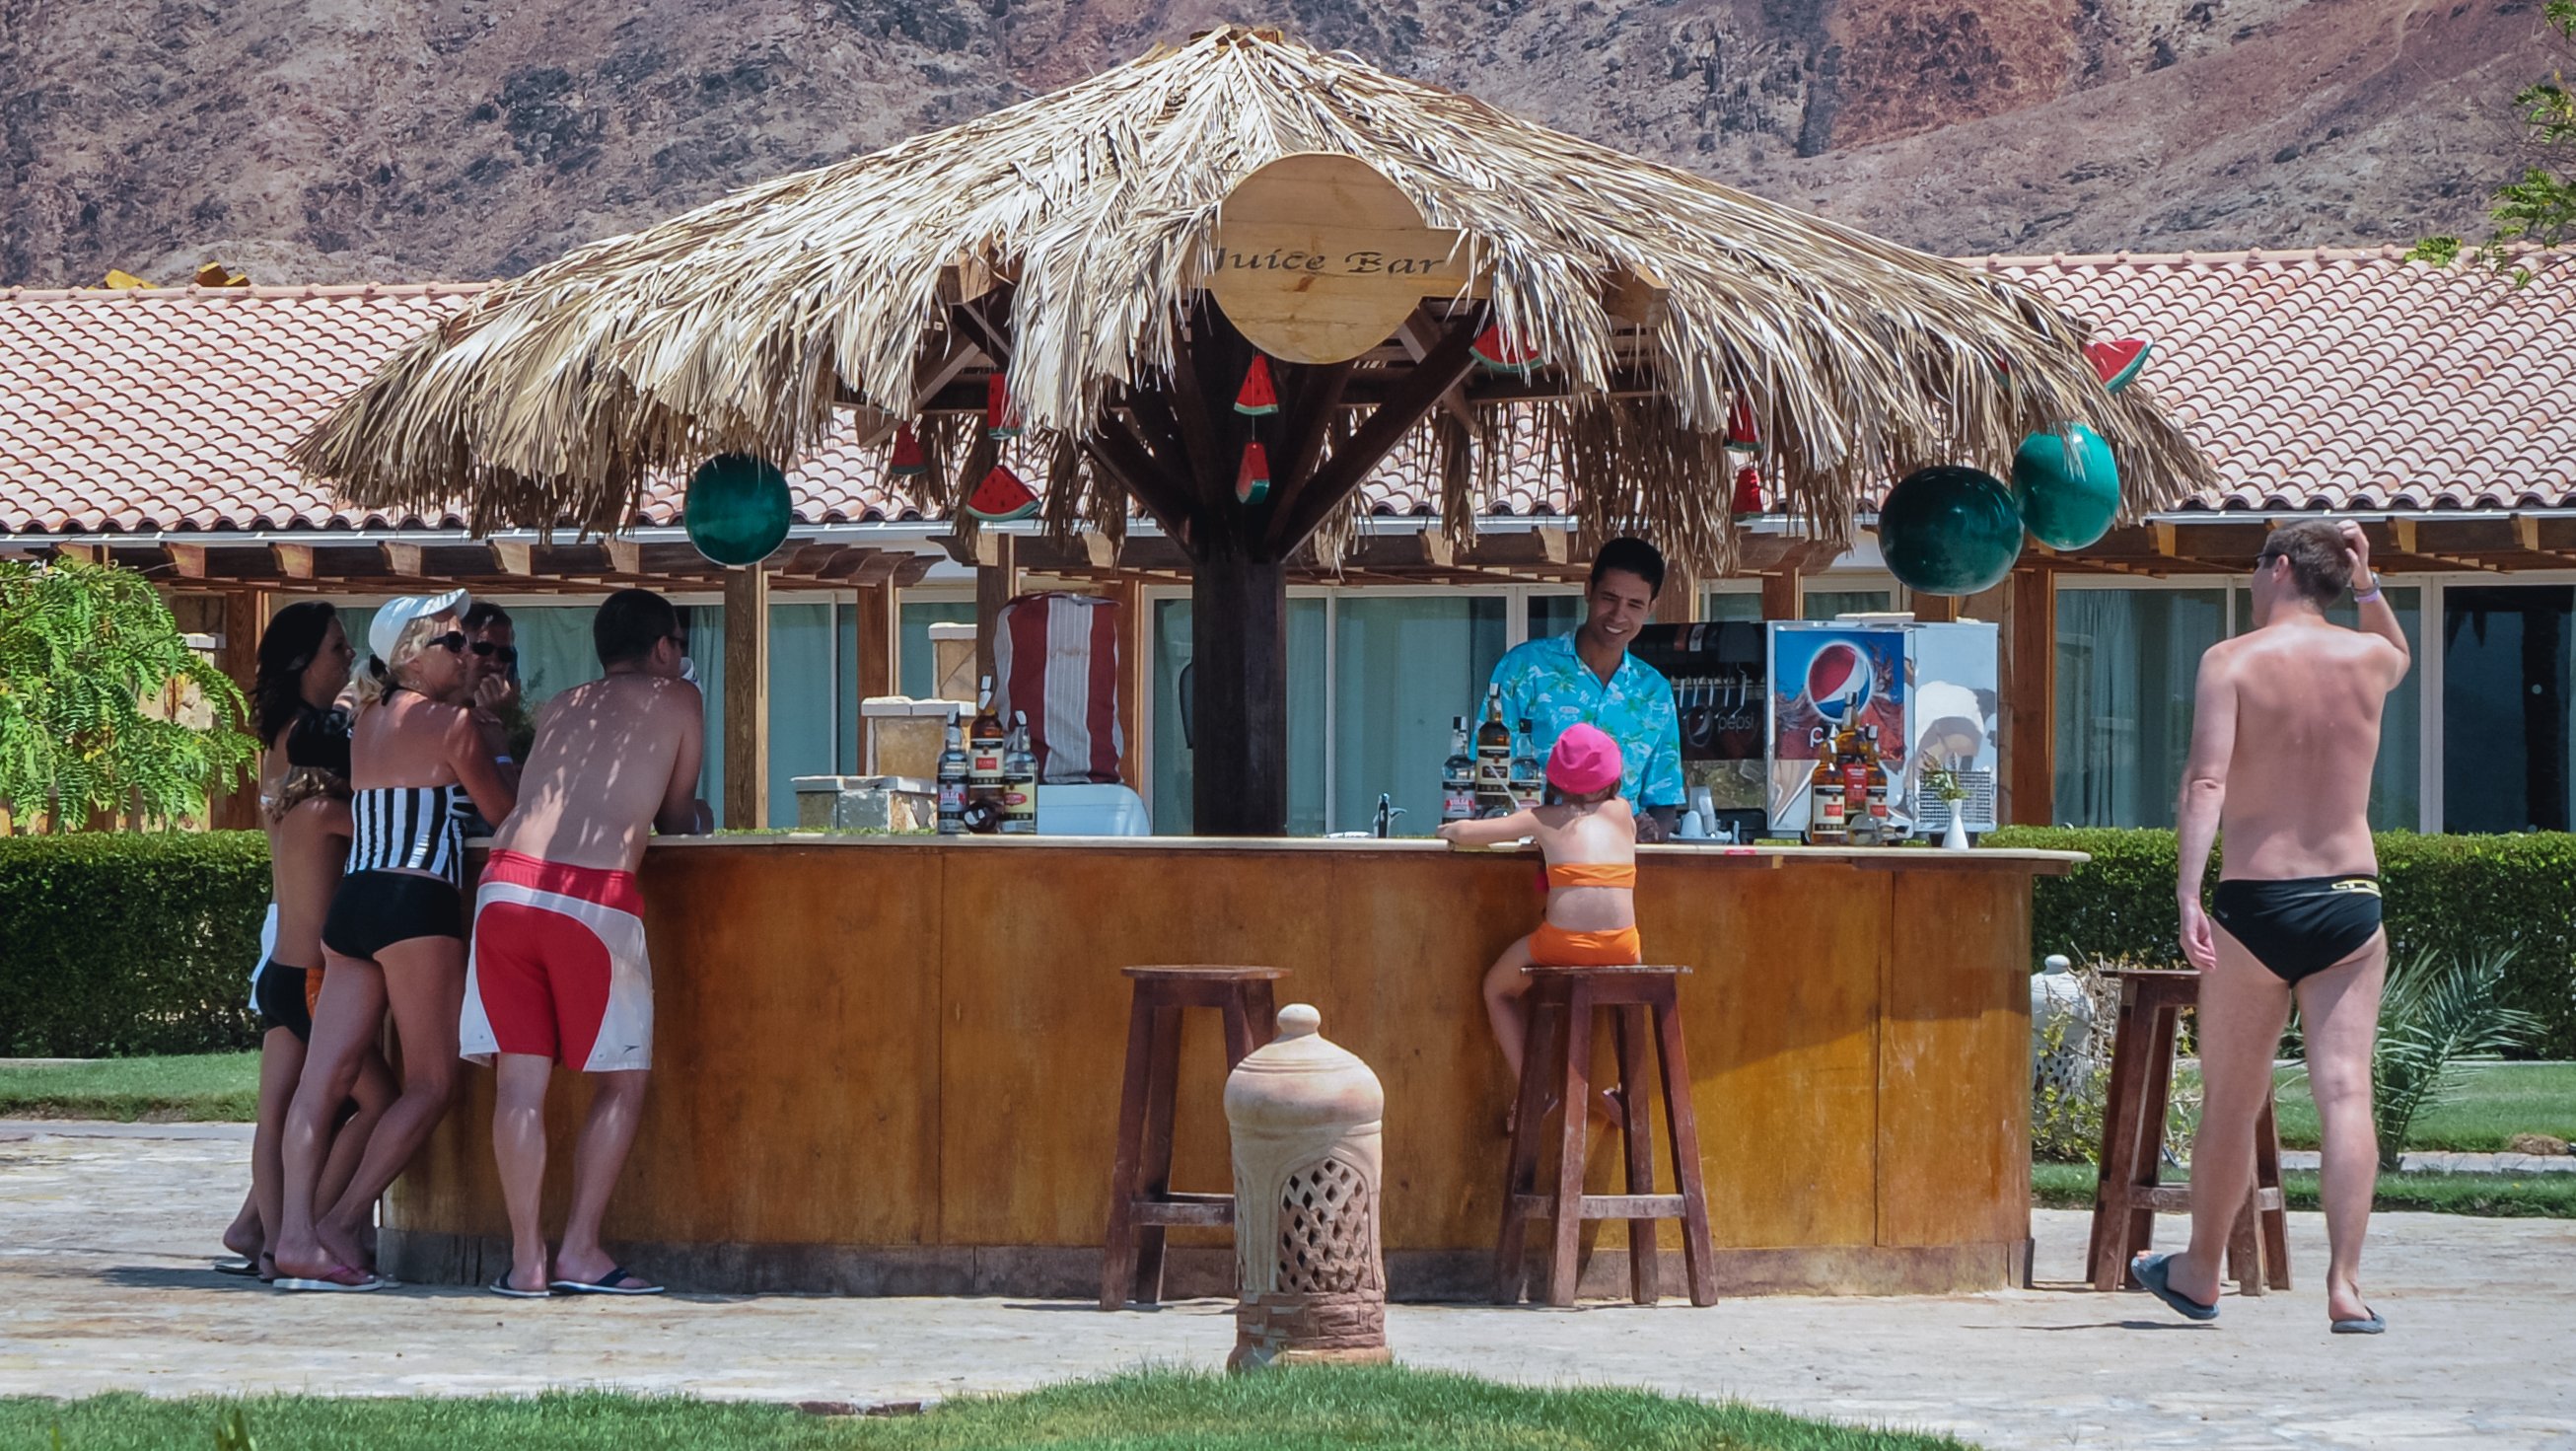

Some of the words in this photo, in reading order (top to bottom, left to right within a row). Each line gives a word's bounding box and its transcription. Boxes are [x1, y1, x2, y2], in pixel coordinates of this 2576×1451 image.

[1212, 247, 1325, 273] Juice
[1344, 251, 1446, 275] Bar
[1717, 711, 1755, 734] pepsi
